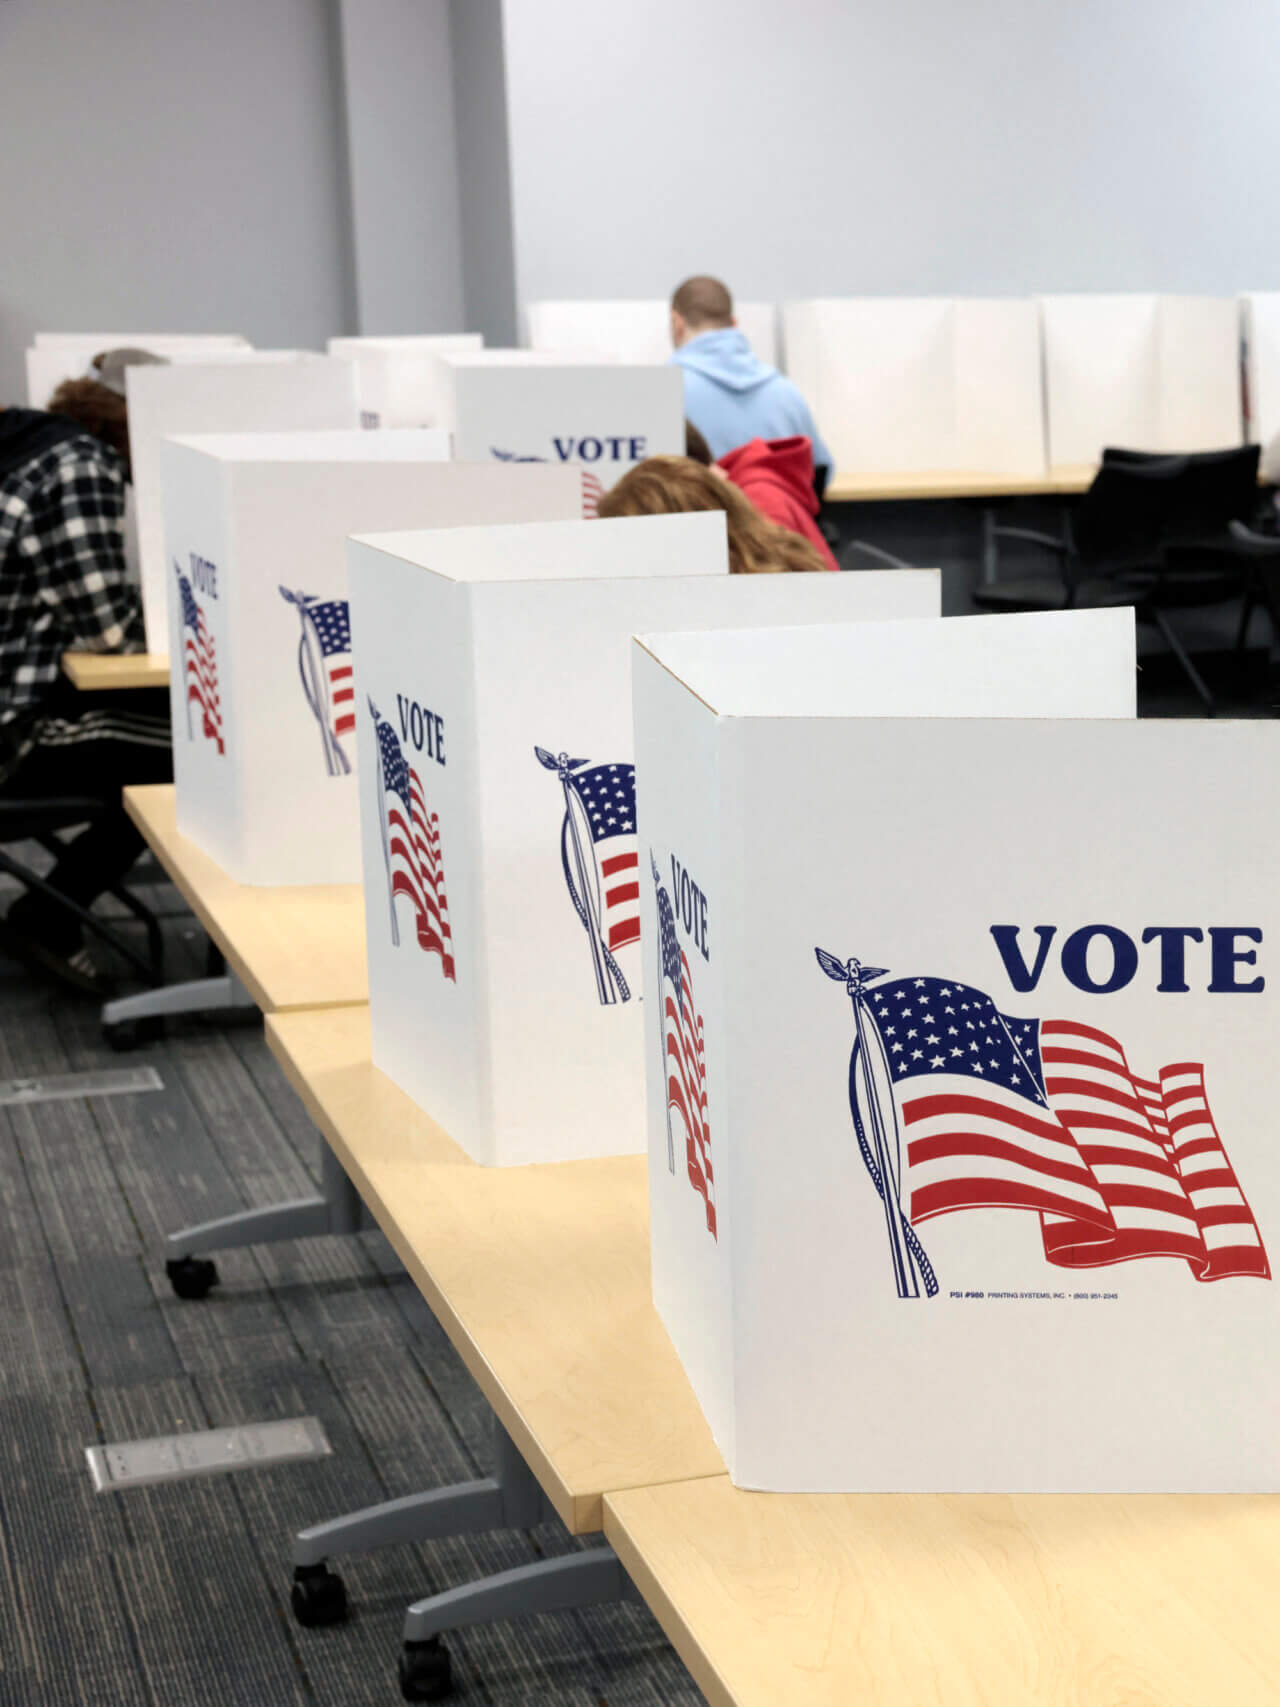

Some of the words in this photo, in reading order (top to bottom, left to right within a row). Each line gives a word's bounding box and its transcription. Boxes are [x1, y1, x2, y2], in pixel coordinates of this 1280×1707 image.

[552, 436, 648, 462] VOTE
[189, 552, 218, 600] VOTE
[396, 693, 446, 767] VOTE
[670, 853, 709, 962] VOTE
[989, 924, 1266, 994] VOTE
